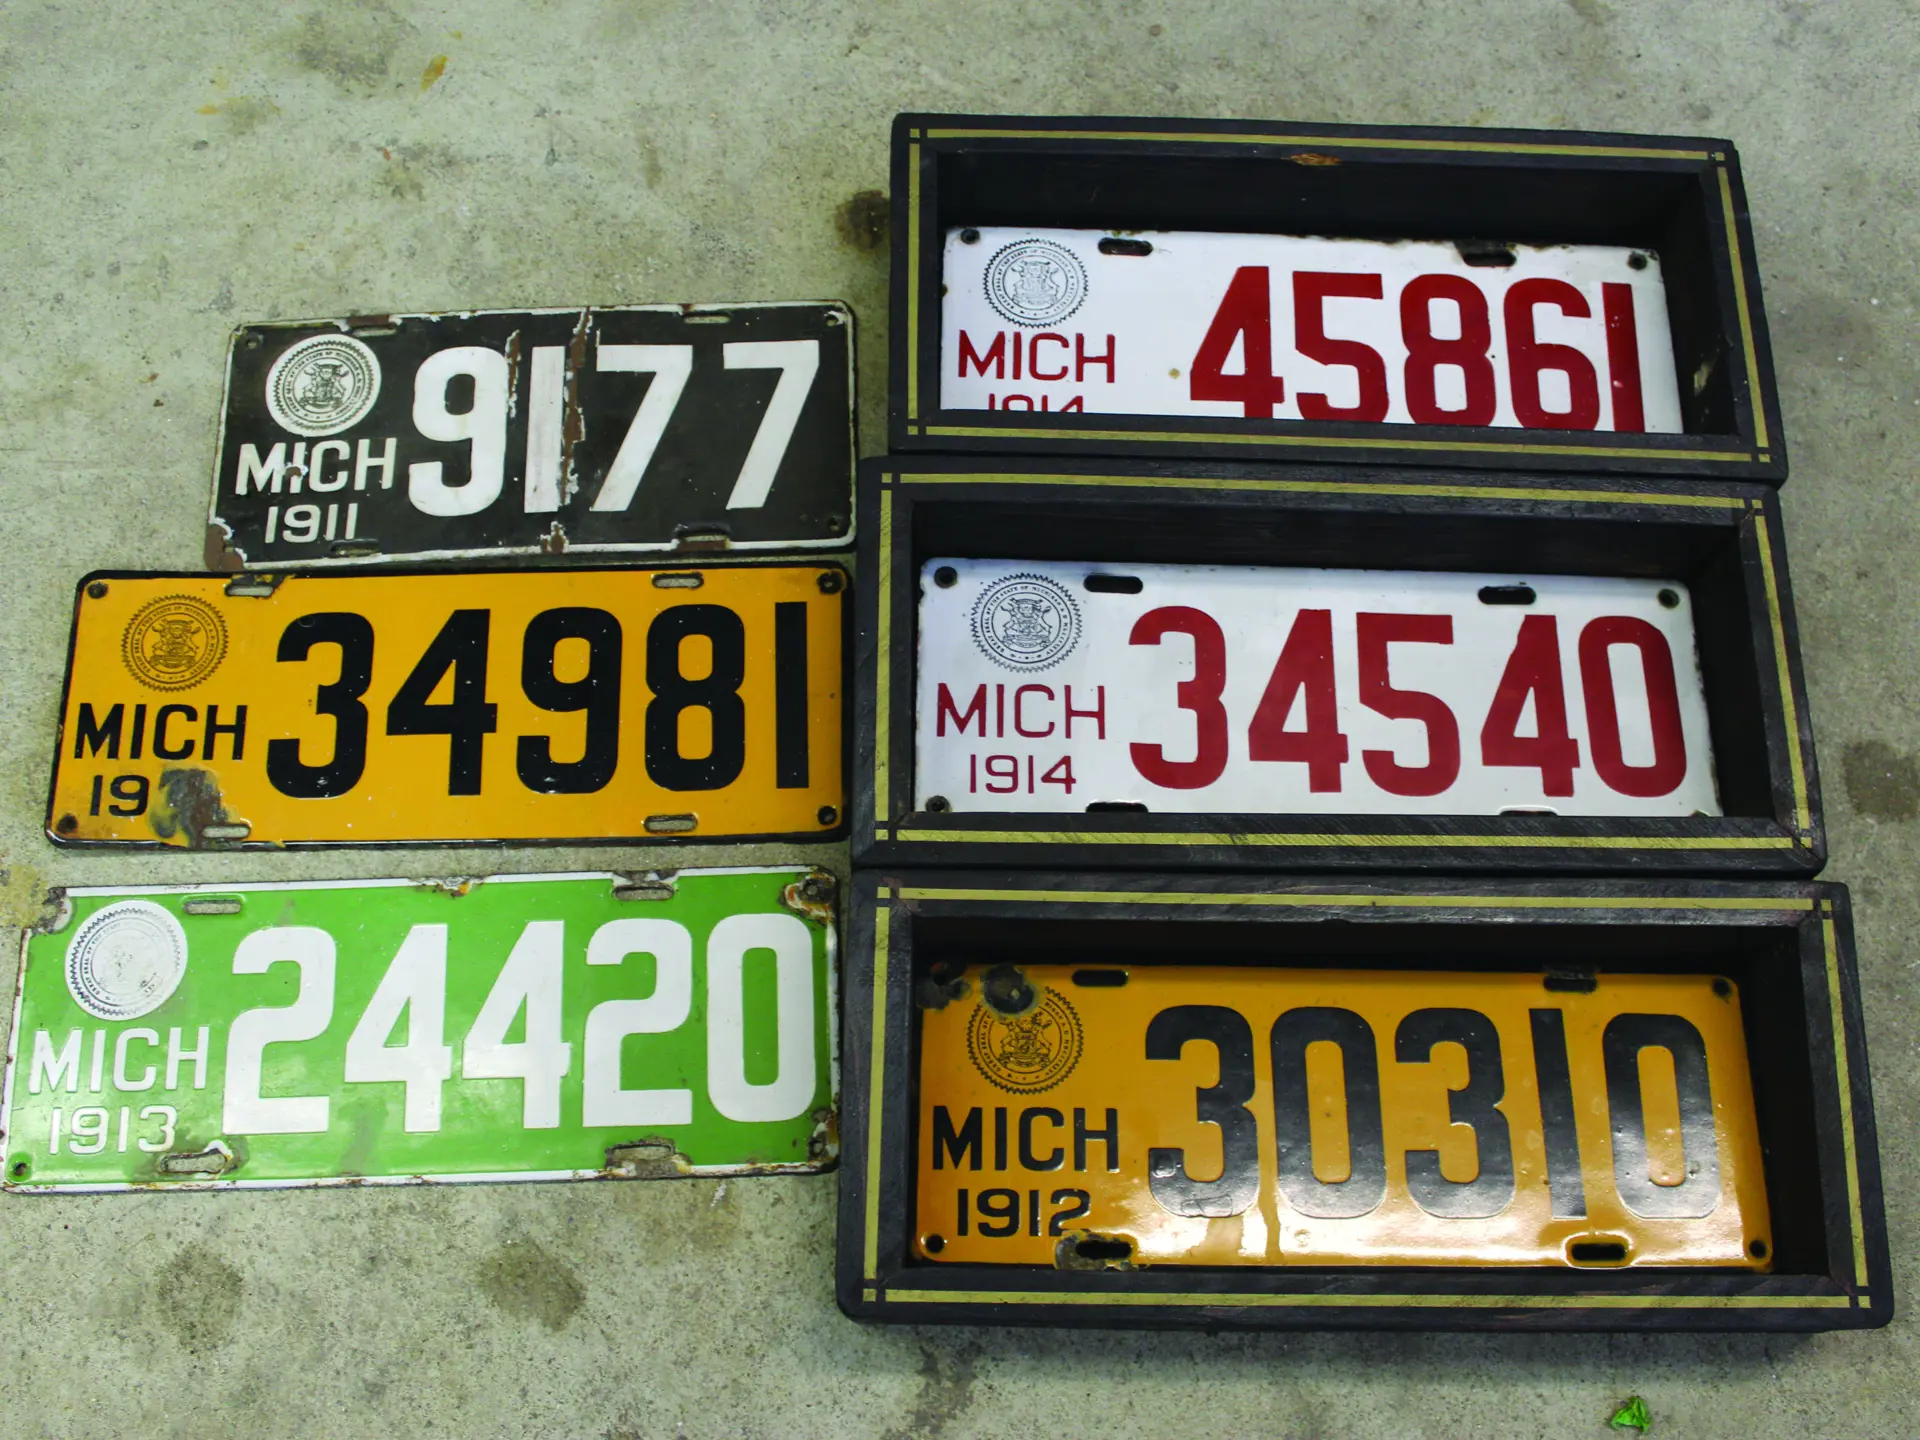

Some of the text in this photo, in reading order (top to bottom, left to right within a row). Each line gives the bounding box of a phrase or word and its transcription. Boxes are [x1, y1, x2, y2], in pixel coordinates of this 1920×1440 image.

[958, 330, 1115, 383] MICH
[1189, 266, 1646, 433] 45861
[409, 340, 820, 517] 9177
[235, 438, 397, 496] MICH
[265, 503, 358, 544] 1911
[266, 601, 810, 799] 34981
[938, 684, 1104, 739] MICH
[1128, 606, 1686, 797] 34540
[75, 703, 247, 760] MICH
[971, 755, 1075, 793] 1914
[222, 913, 817, 1134] 24420
[29, 1026, 210, 1094] MICH
[50, 1105, 177, 1156] 1913
[932, 1105, 1119, 1172] MICH
[1144, 1005, 1723, 1220] 30310
[957, 1188, 1091, 1237] 1912
